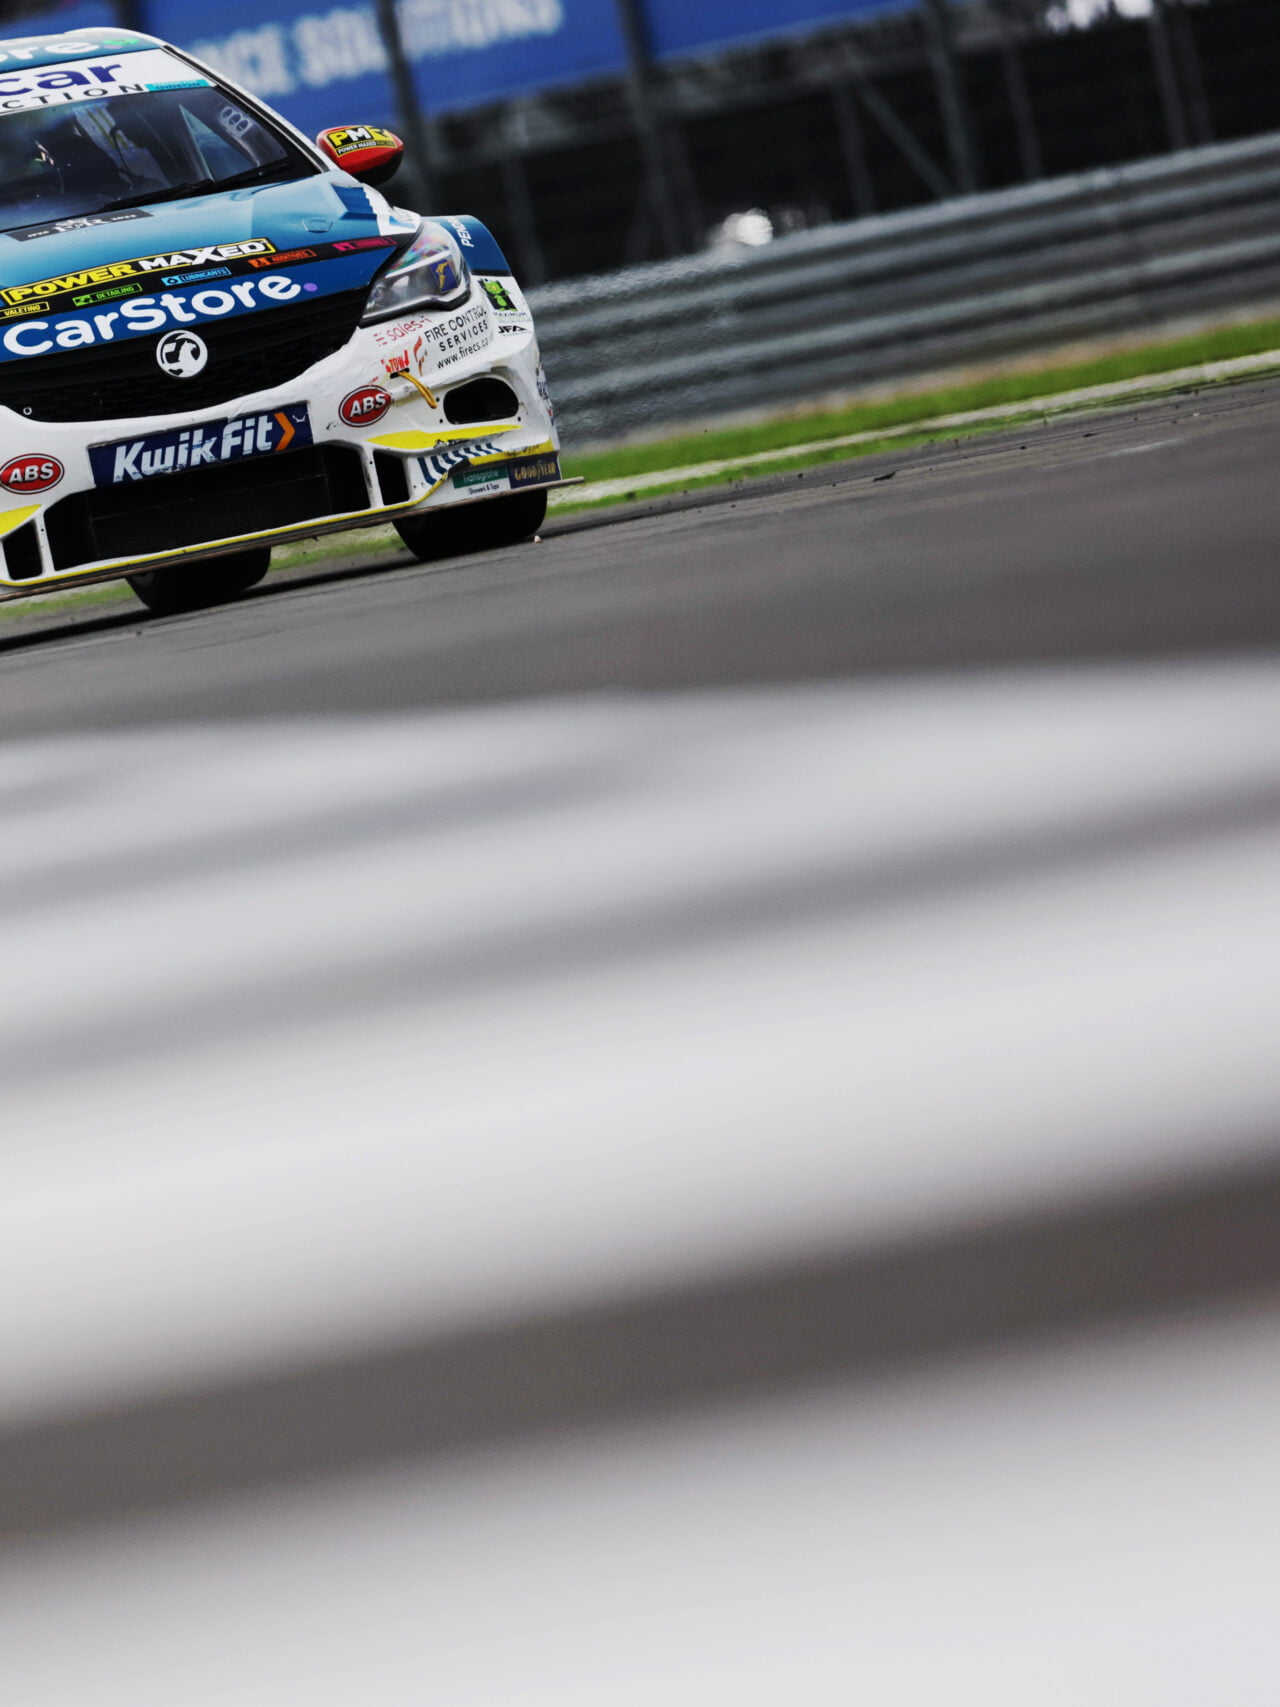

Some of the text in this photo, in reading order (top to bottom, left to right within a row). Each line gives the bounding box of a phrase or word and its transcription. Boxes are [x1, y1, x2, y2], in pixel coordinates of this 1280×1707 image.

[6, 241, 267, 302] POWER MAXED
[181, 268, 228, 282] LUBRICANTS
[95, 285, 135, 301] DETAILING
[4, 304, 41, 318] VALETING
[386, 314, 433, 342] sales-i
[424, 323, 448, 343] FIRE
[439, 320, 489, 352] SERVICES
[349, 393, 387, 418] ABS
[8, 462, 55, 484] ABS
